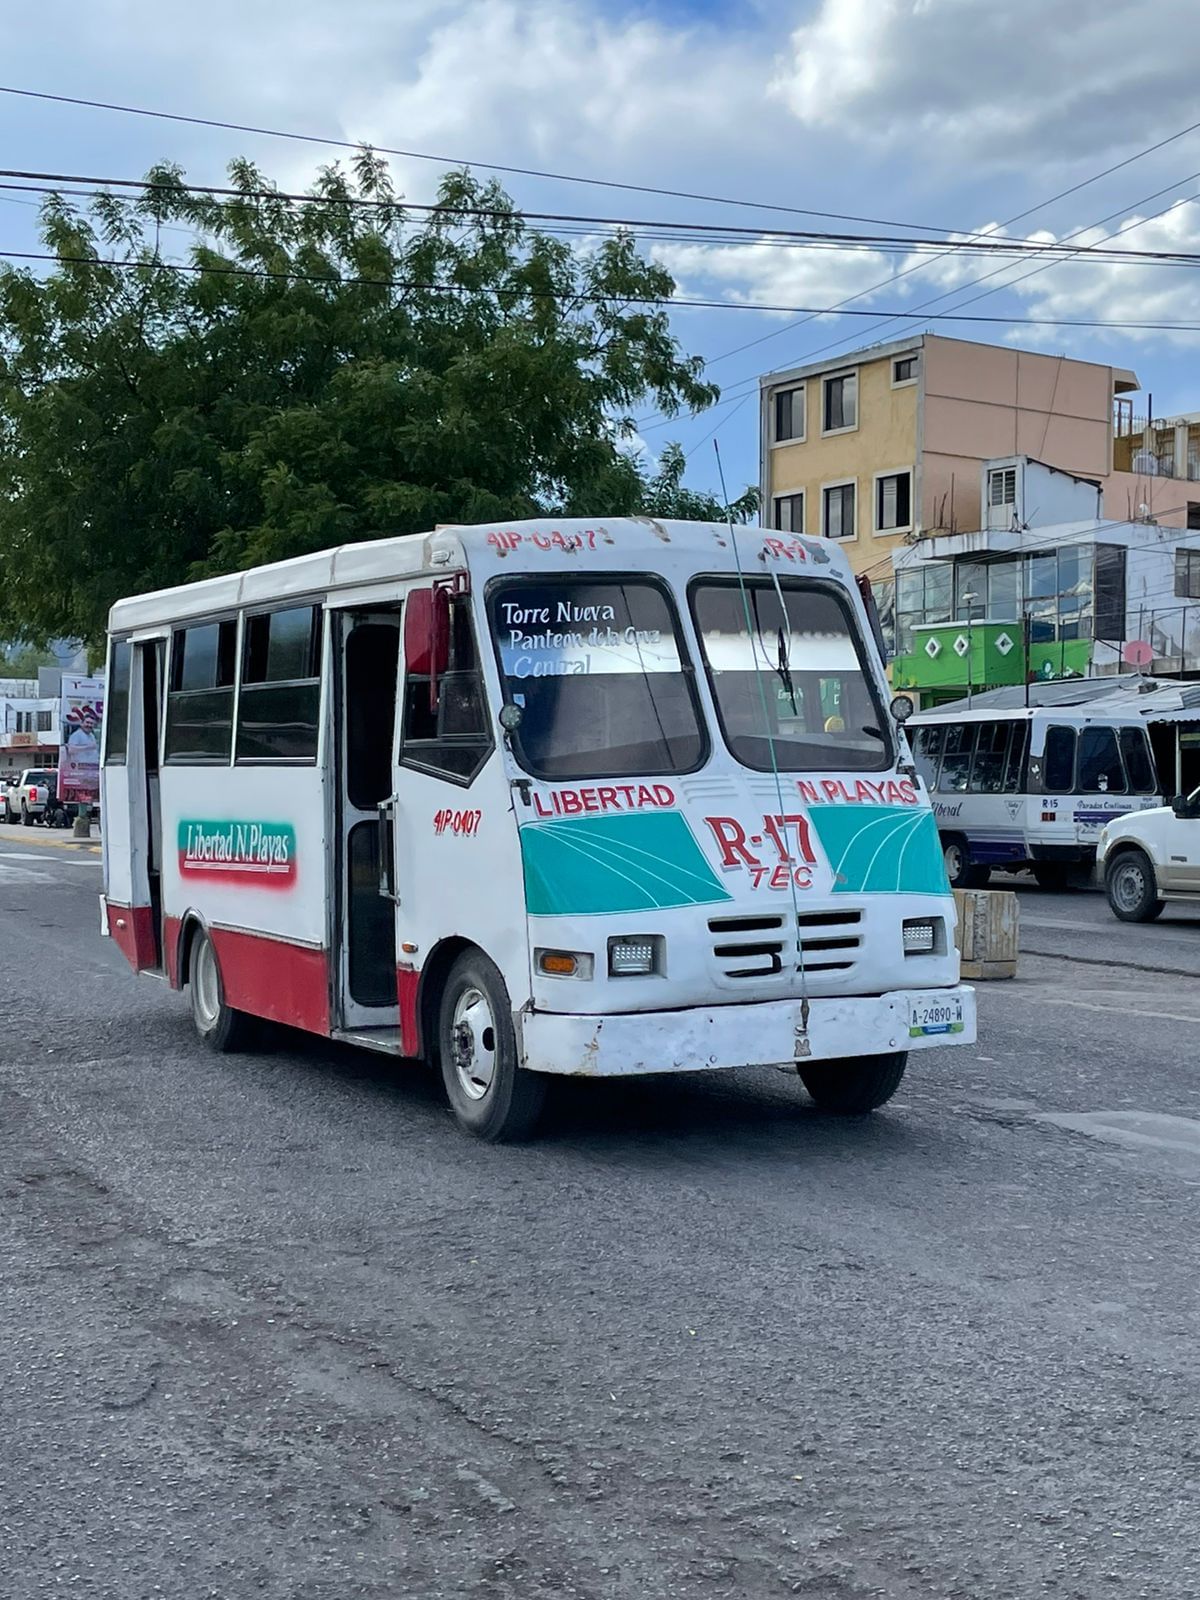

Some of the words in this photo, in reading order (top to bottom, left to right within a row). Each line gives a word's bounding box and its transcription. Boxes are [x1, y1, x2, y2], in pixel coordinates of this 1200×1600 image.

[502, 602, 550, 624] Torre
[556, 601, 615, 623] Nueva
[533, 783, 676, 818] LIBERTAD
[185, 823, 235, 863] Libertad
[703, 814, 819, 869] R-17
[749, 864, 815, 890] TEC
